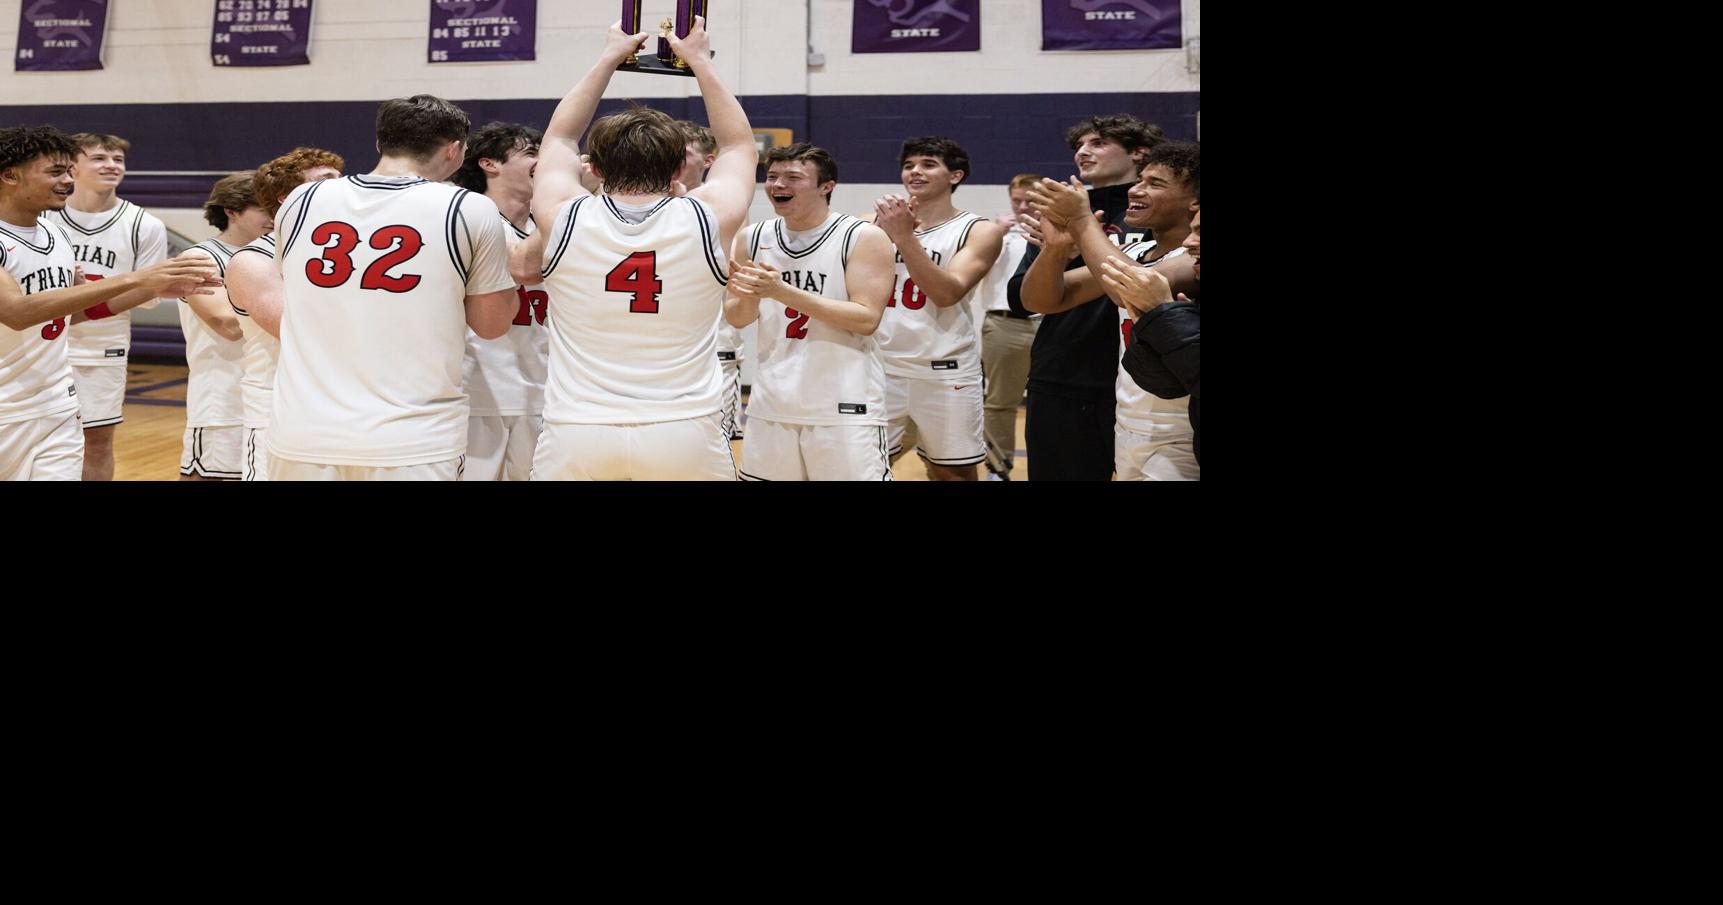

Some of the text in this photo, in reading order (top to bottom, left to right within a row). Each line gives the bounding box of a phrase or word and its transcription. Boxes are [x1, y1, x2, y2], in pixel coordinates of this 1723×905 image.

[1084, 11, 1137, 20] STATE
[33, 19, 93, 28] SECTIONAL
[447, 17, 518, 27] SECTIONAL
[229, 24, 294, 33] SECTIONAL
[433, 28, 449, 39] 84
[453, 27, 470, 38] 85
[475, 26, 486, 37] 11
[891, 28, 940, 38] STATE
[43, 40, 79, 48] STATE
[462, 40, 501, 48] STATE
[241, 46, 278, 54] STATE
[432, 50, 448, 61] 85
[72, 244, 117, 269] RIAD
[305, 221, 425, 293] 32
[605, 250, 662, 314] 4
[785, 306, 810, 340] 2
